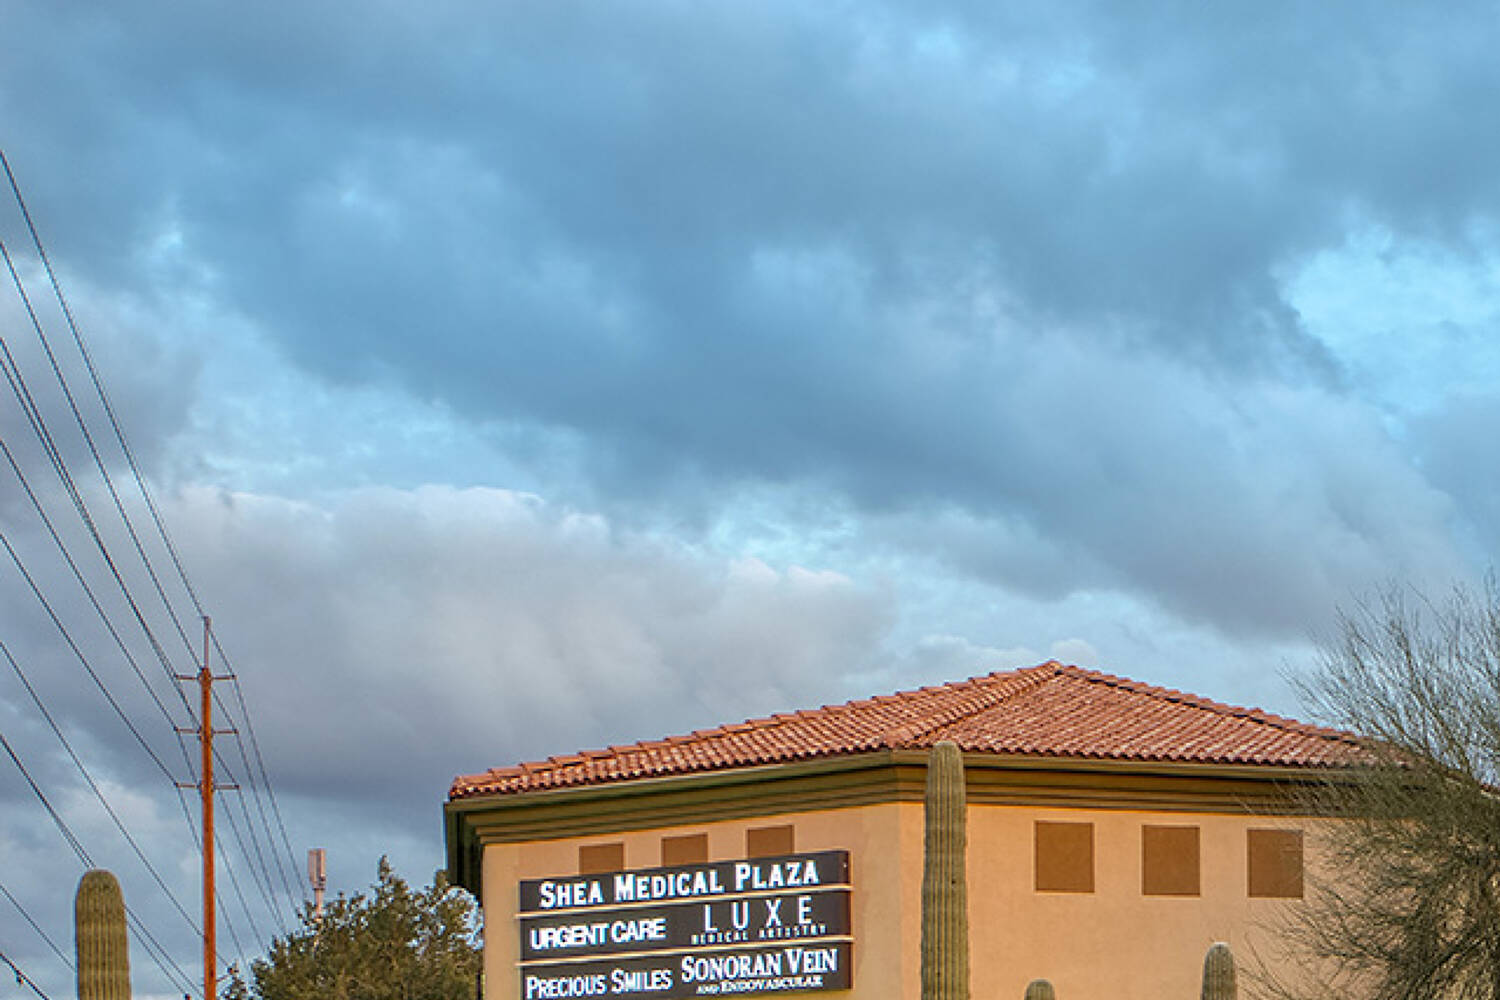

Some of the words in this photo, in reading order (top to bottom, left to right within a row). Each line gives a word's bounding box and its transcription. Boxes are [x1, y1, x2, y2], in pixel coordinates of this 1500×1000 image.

[540, 881, 603, 908] SHEA
[614, 871, 724, 902] MEDICAL
[735, 860, 818, 891] PLAZA
[704, 896, 812, 932] LUXE
[531, 923, 609, 949] URGENT
[611, 918, 666, 943] CARE
[691, 930, 748, 945] MEDICAL
[681, 953, 781, 982] SONORAN
[785, 949, 838, 974] VEIN
[526, 975, 607, 1000] PRECIOUS
[611, 968, 673, 993] SMILES
